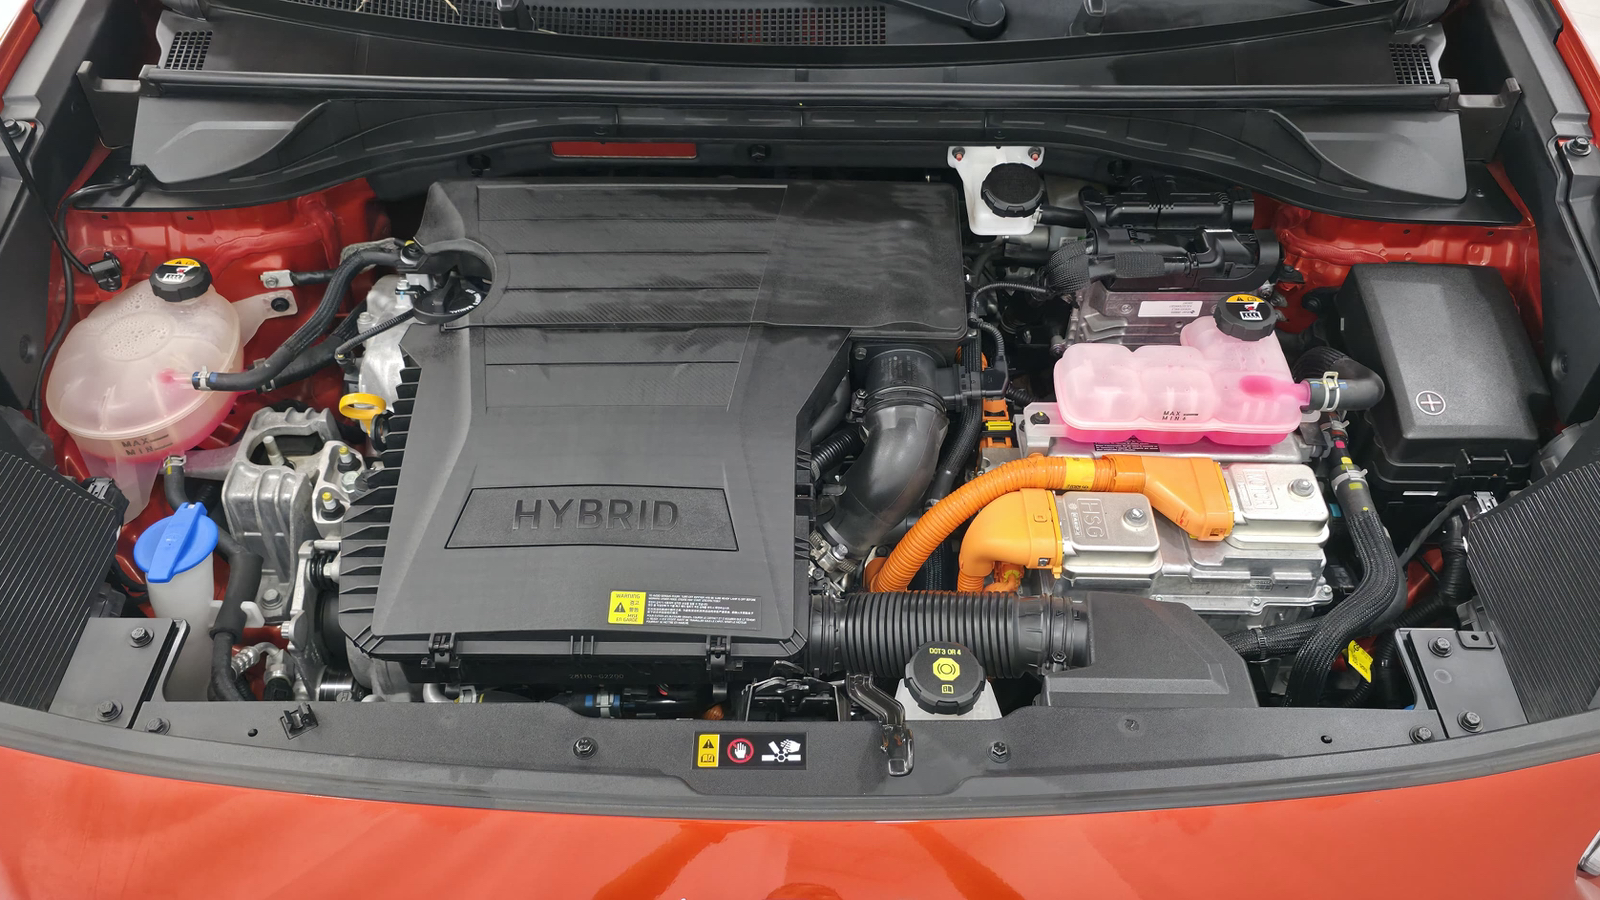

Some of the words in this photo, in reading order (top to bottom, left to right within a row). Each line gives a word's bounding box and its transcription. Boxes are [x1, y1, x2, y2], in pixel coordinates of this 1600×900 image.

[121, 437, 149, 448] MAX
[125, 445, 154, 456] MIN
[512, 498, 679, 531] HYBRID
[1080, 501, 1106, 538] HSG
[947, 648, 956, 656] OR
